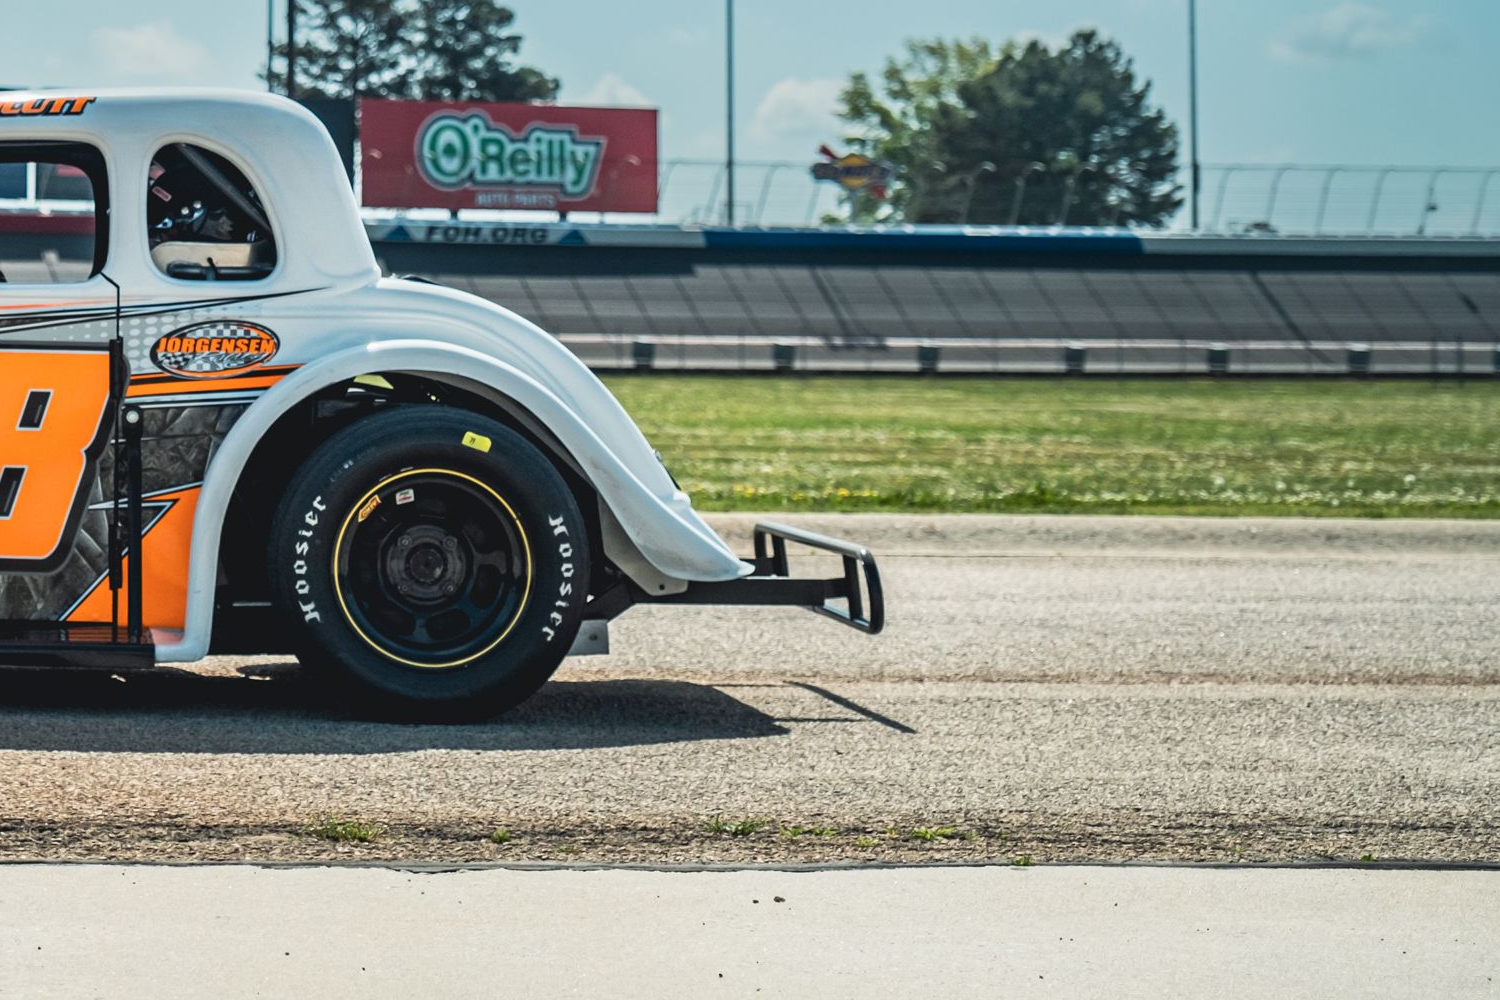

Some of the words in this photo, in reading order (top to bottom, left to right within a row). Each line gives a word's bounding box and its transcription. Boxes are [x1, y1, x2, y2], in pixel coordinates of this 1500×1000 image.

[424, 115, 600, 194] O'Reilly
[424, 226, 549, 243] FOH.ORG
[155, 336, 275, 355] JORGENSEN
[293, 495, 327, 625] Hoosier
[542, 513, 574, 642] Hoosier
